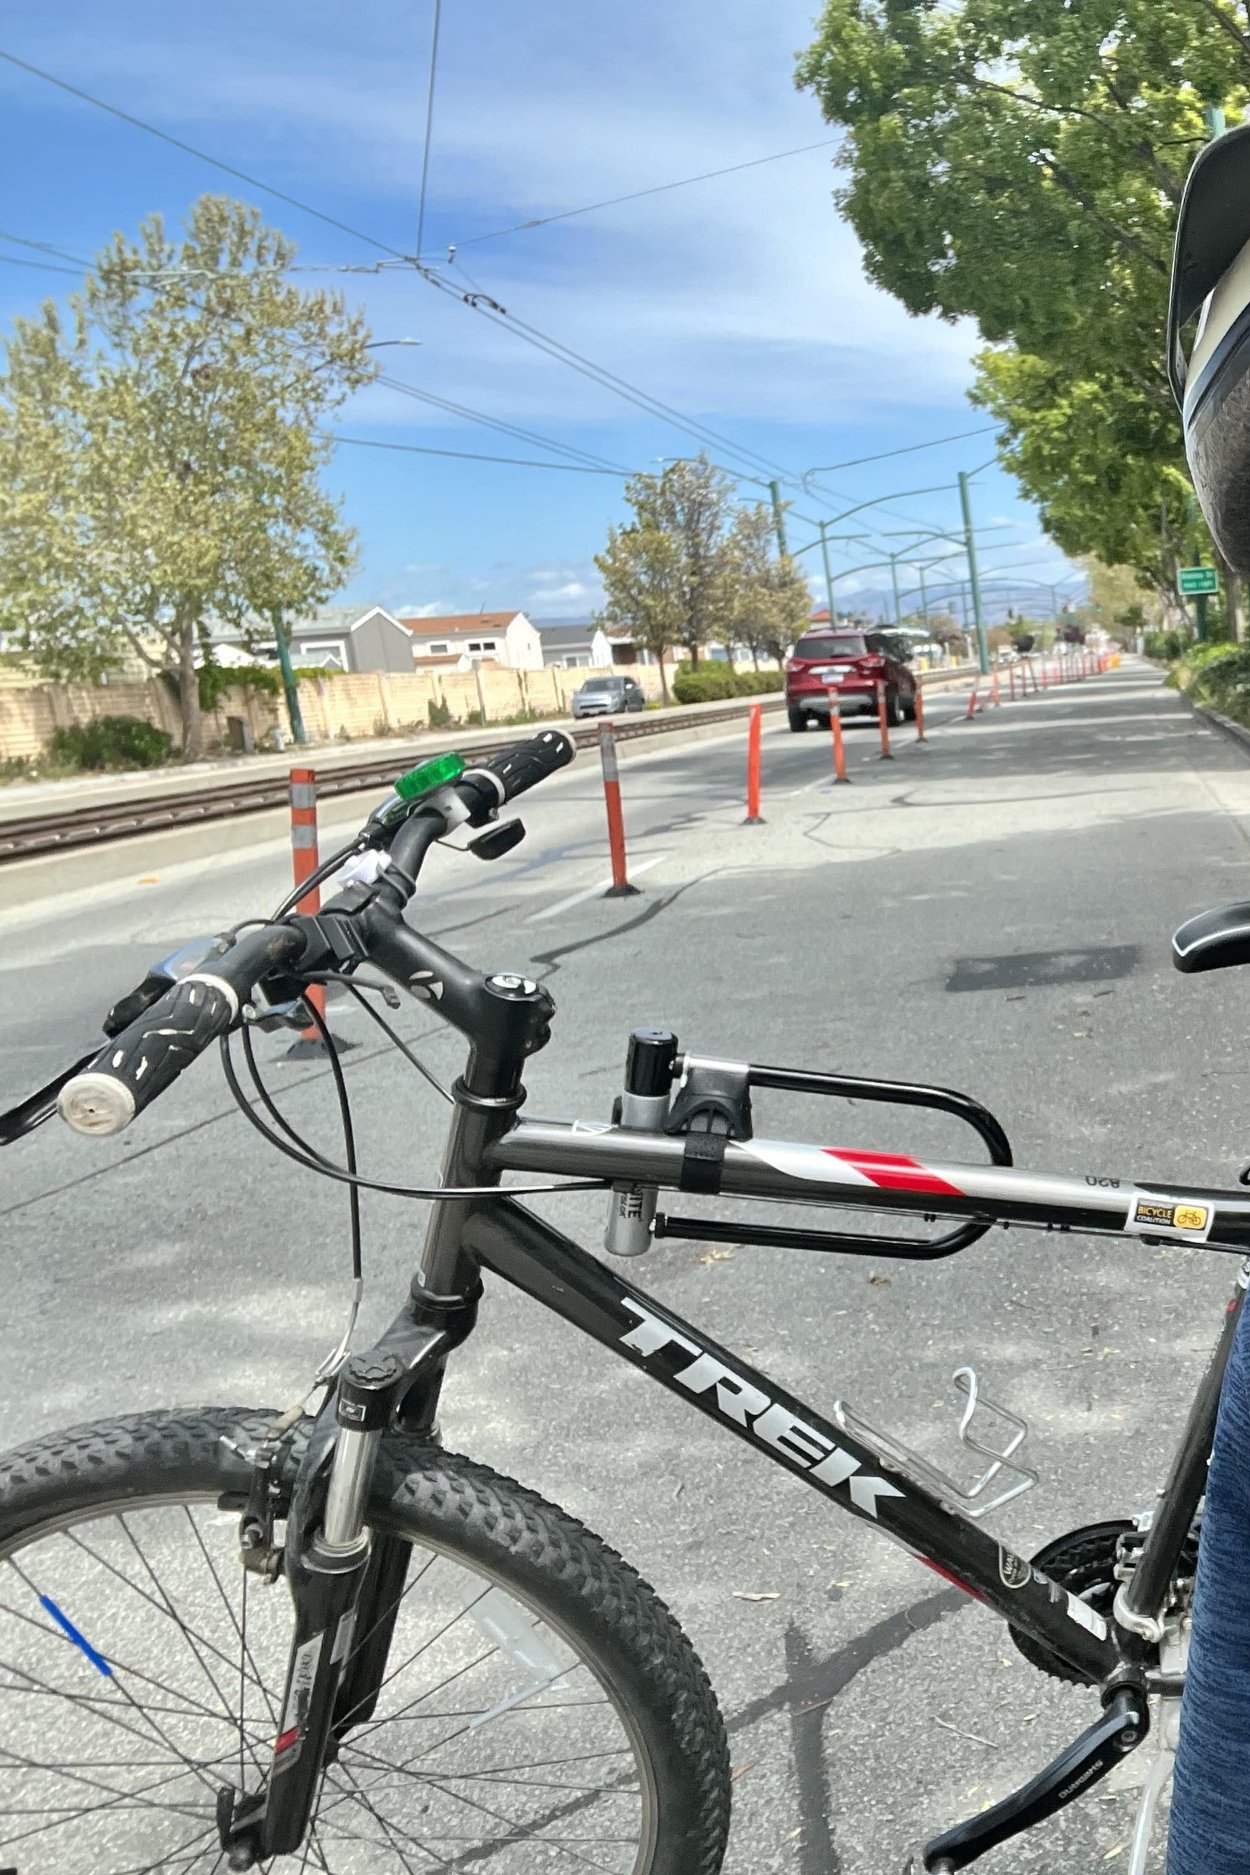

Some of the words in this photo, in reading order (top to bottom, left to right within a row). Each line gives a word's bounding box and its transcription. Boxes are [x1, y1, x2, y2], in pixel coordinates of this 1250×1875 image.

[1085, 1175, 1120, 1189] 820
[1138, 1206, 1173, 1219] BICYCLE
[1137, 1214, 1171, 1225] COALITION
[619, 1297, 907, 1519] TREK
